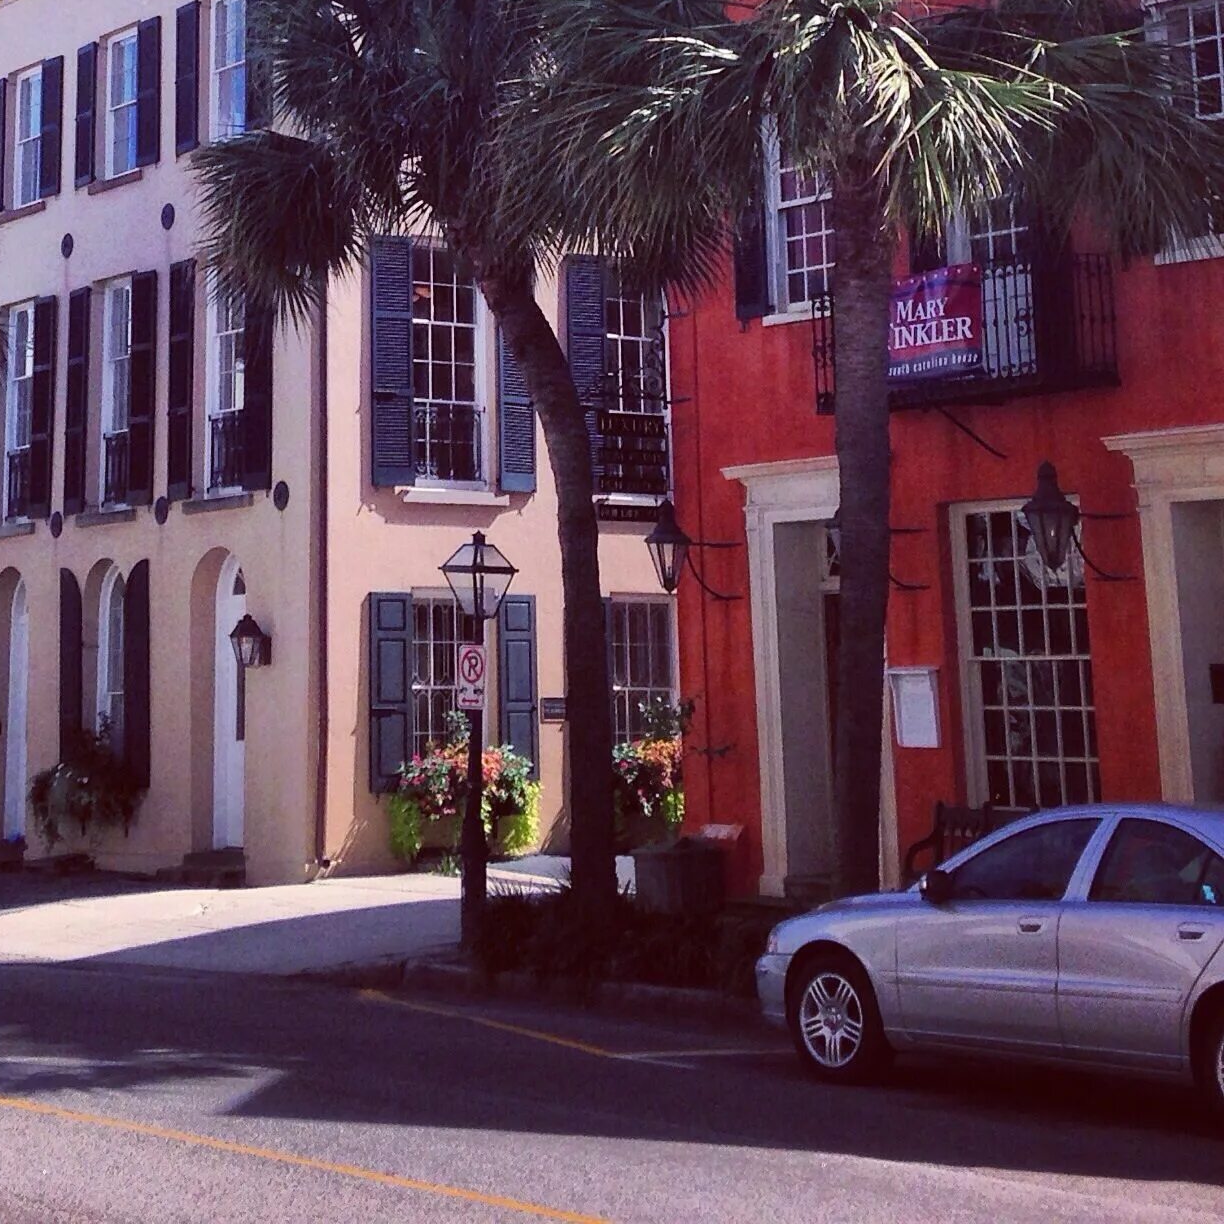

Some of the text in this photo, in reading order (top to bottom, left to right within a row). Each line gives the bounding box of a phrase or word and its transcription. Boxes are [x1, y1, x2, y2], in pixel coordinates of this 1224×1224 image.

[897, 297, 948, 323] MARY
[888, 317, 973, 350] INKLER
[888, 353, 978, 376] south carolina house
